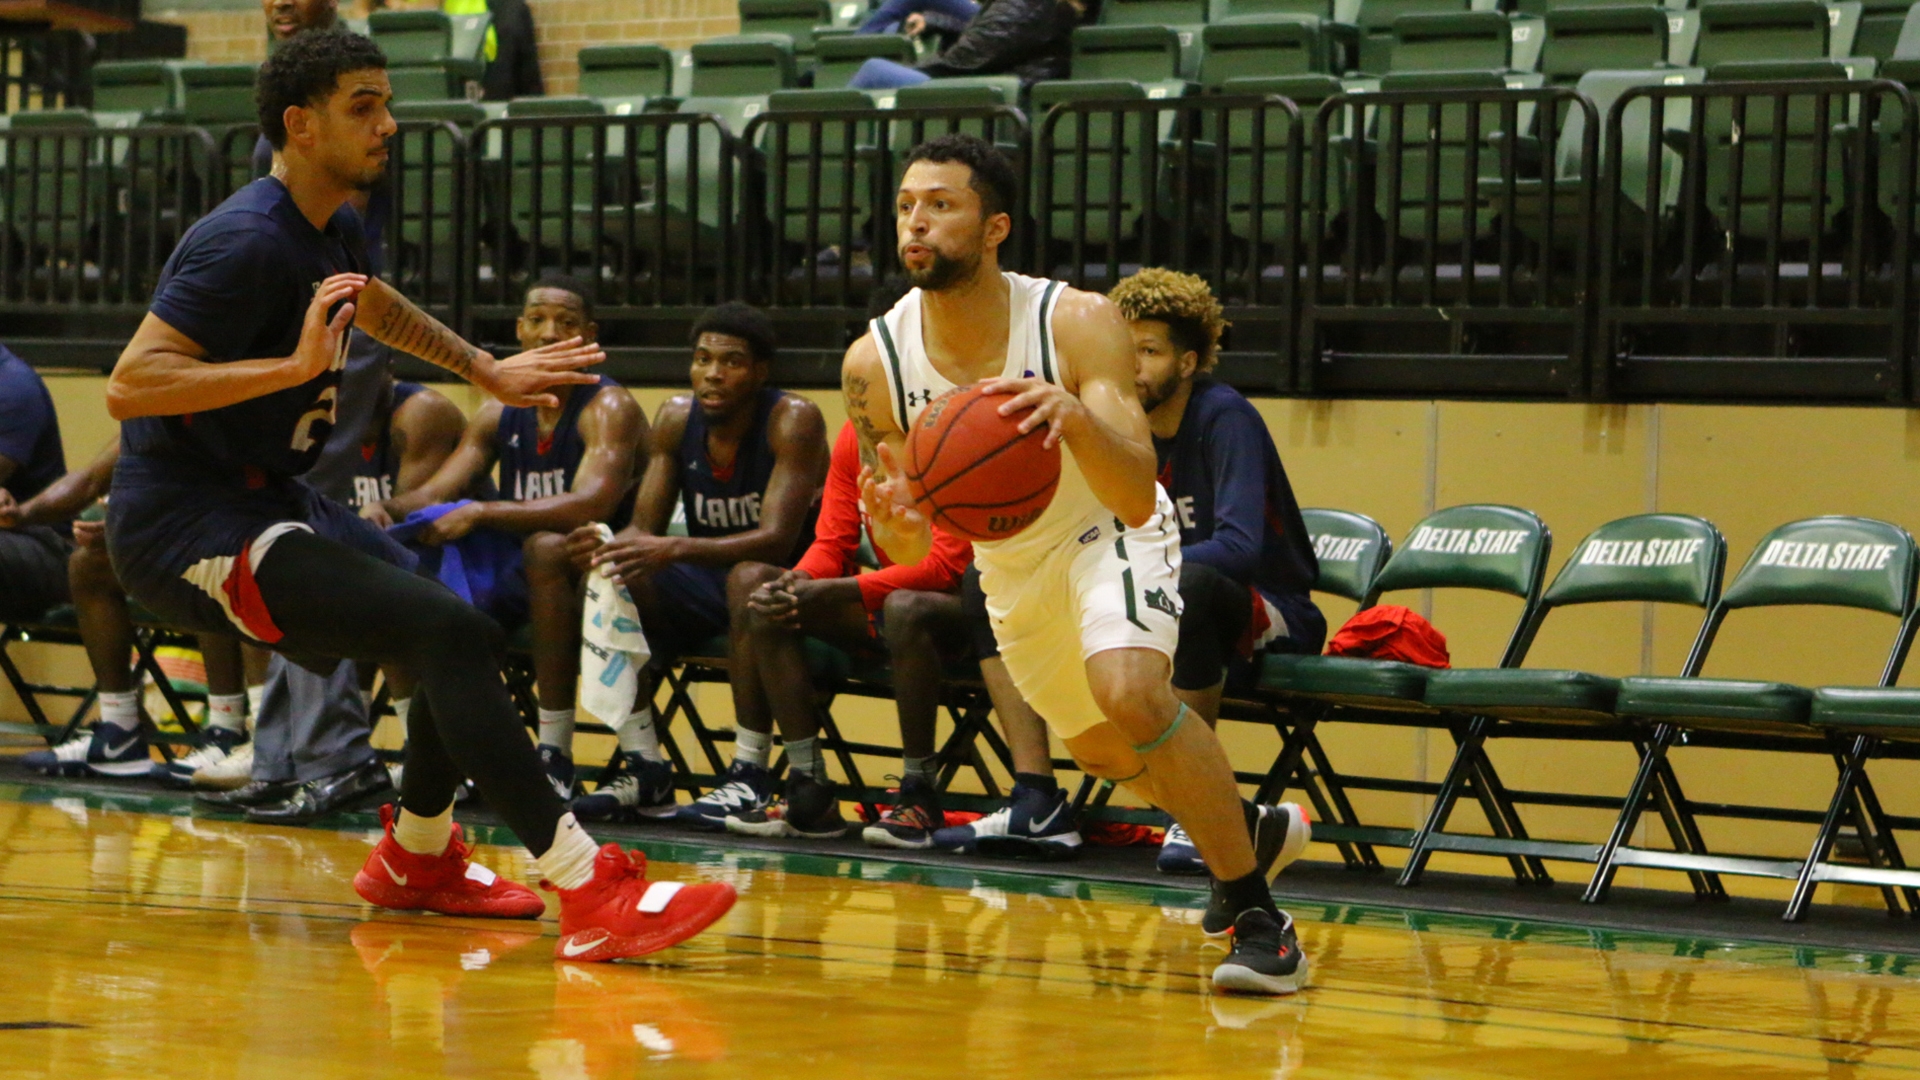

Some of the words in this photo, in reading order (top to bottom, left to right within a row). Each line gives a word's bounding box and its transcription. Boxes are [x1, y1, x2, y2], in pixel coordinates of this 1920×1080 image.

[349, 474, 392, 506] ANE
[694, 491, 761, 528] LANE
[1315, 534, 1372, 561] STATE
[1410, 525, 1471, 551] DELTA
[1469, 527, 1531, 555] STATE
[1579, 538, 1645, 566] DELTA
[1642, 537, 1706, 566] STATE
[1759, 538, 1829, 569] DELTA
[1827, 541, 1897, 571] STATE
